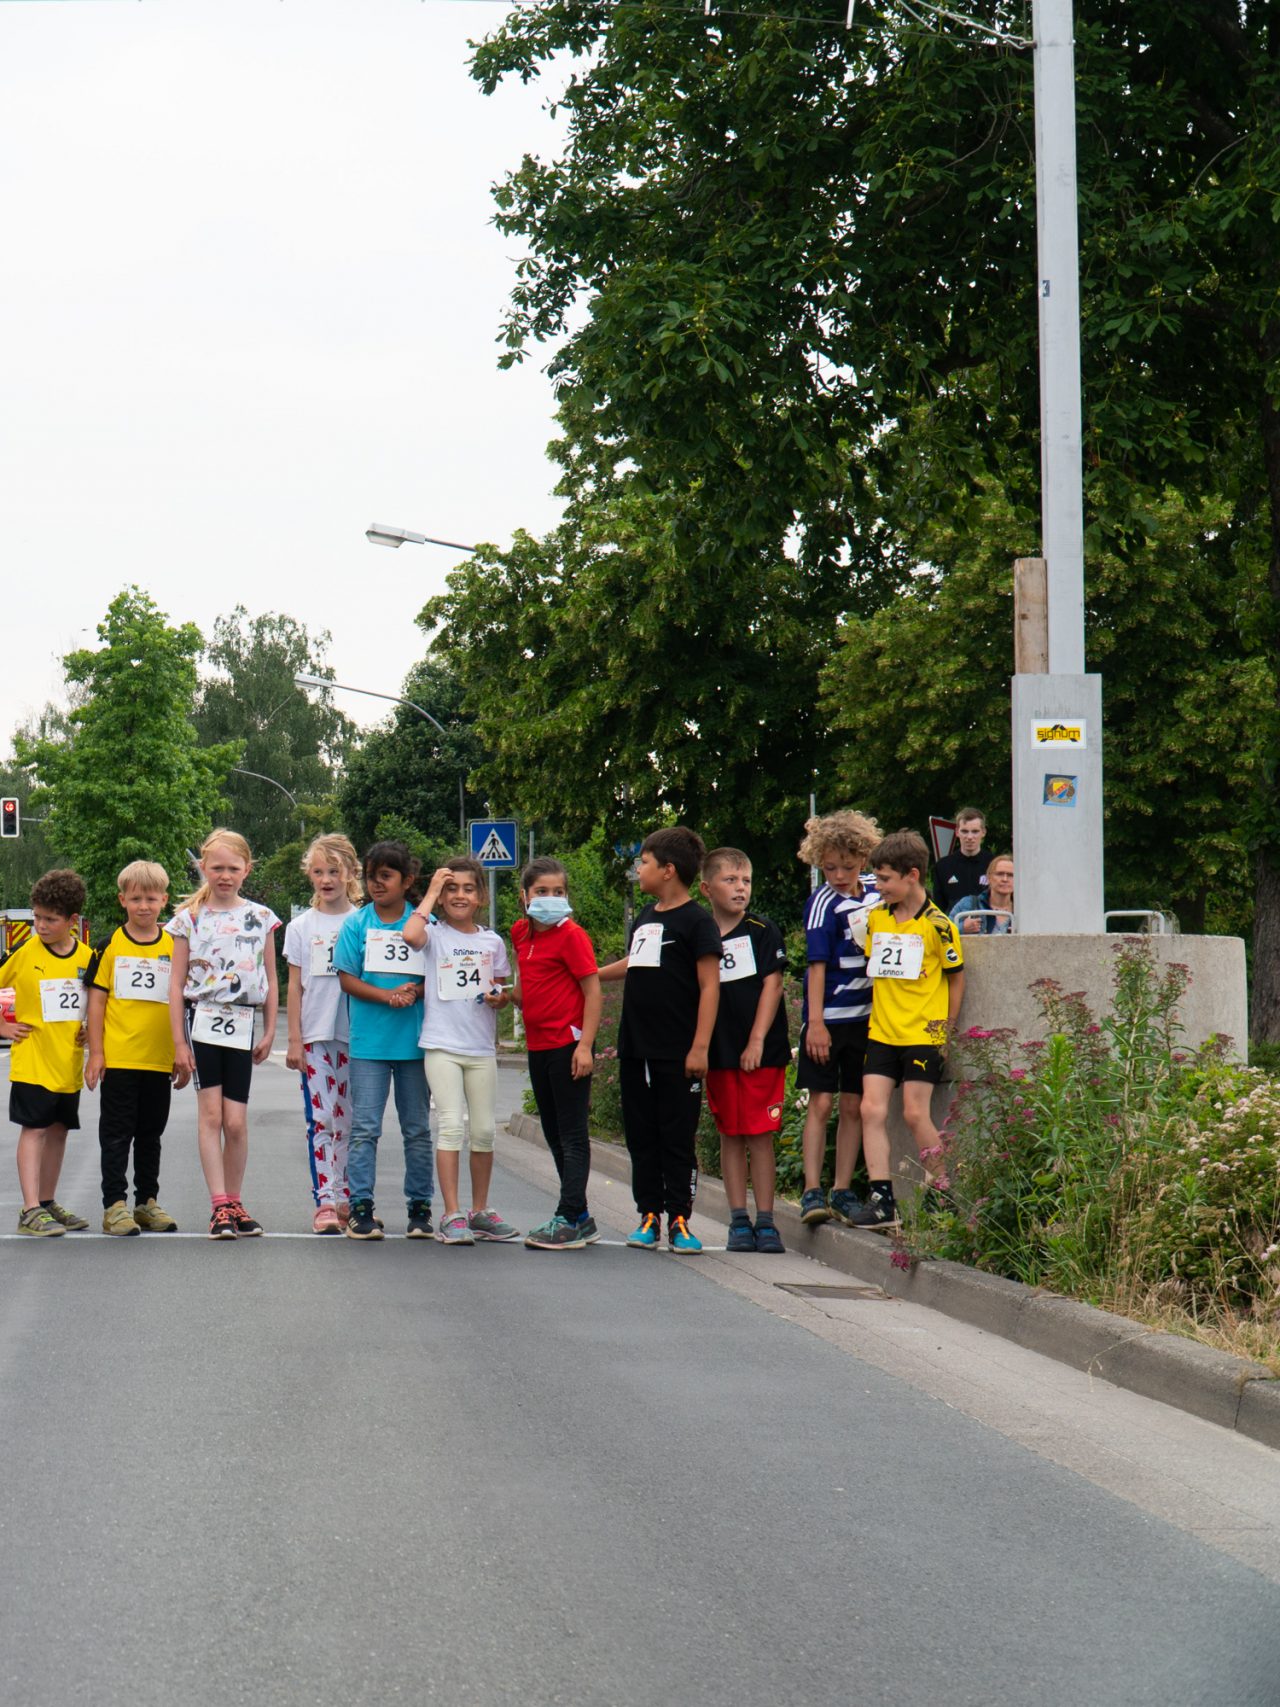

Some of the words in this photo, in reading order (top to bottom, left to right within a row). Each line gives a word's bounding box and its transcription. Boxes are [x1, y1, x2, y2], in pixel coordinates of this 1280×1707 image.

[1037, 729, 1081, 741] signum
[384, 944, 410, 961] 33
[720, 952, 736, 970] 8
[881, 947, 903, 966] 21
[131, 971, 155, 989] 23
[456, 968, 482, 988] 34
[878, 967, 905, 976] Lennox
[59, 992, 80, 1009] 22
[211, 1016, 235, 1036] 26
